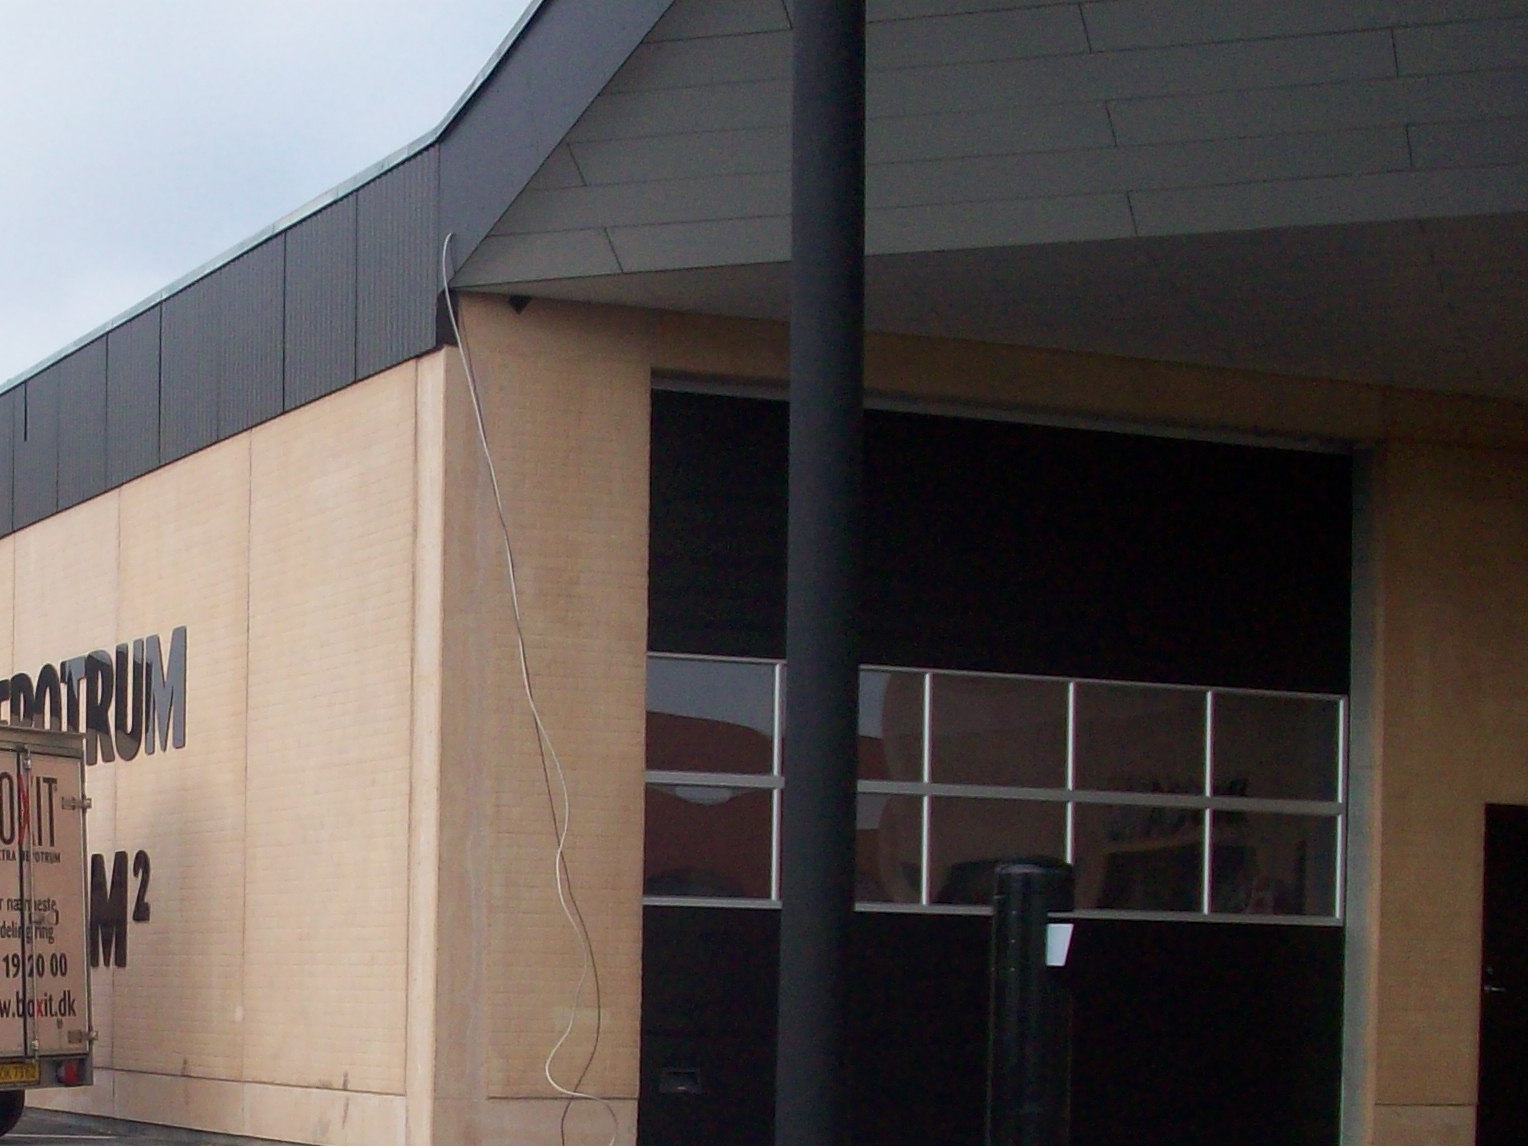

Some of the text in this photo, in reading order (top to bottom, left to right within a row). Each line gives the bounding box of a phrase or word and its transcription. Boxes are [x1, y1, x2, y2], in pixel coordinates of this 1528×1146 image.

[22, 850, 61, 863] DEOTRUM
[2, 953, 20, 978] 19
[27, 953, 45, 978] 20
[50, 953, 67, 977] 00
